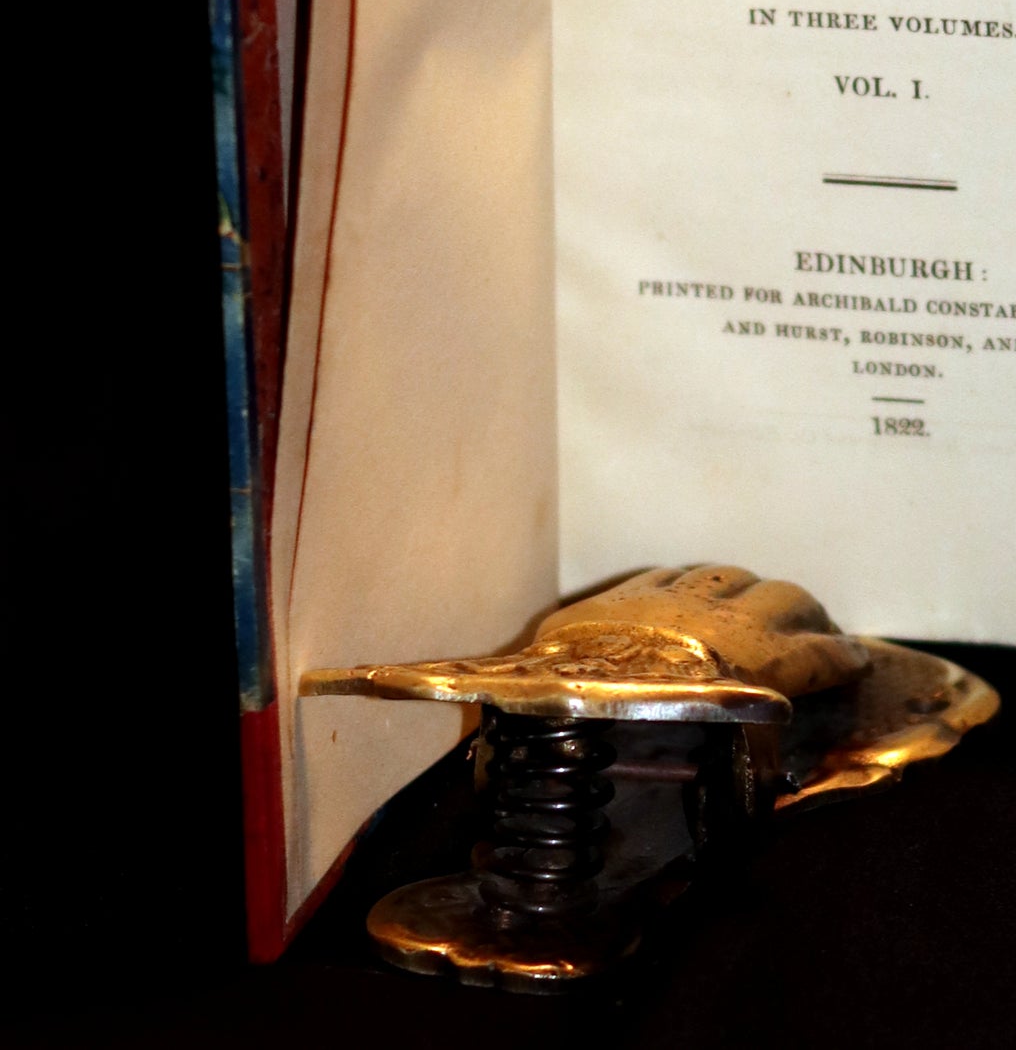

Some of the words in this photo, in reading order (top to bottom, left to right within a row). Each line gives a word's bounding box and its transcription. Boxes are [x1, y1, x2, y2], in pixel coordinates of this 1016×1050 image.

[748, 8, 777, 26] IN
[787, 10, 878, 31] THREE
[833, 75, 897, 99] VOL.
[911, 79, 930, 100] I.
[638, 281, 734, 301] PRINTED
[743, 286, 783, 306] FOR
[793, 291, 918, 314] ARCHIBALD
[722, 320, 766, 336] AND
[775, 323, 851, 346] HURST,
[860, 330, 973, 353] ROBINSON,
[852, 360, 944, 379] LONDON.
[872, 416, 931, 437] 1822.
